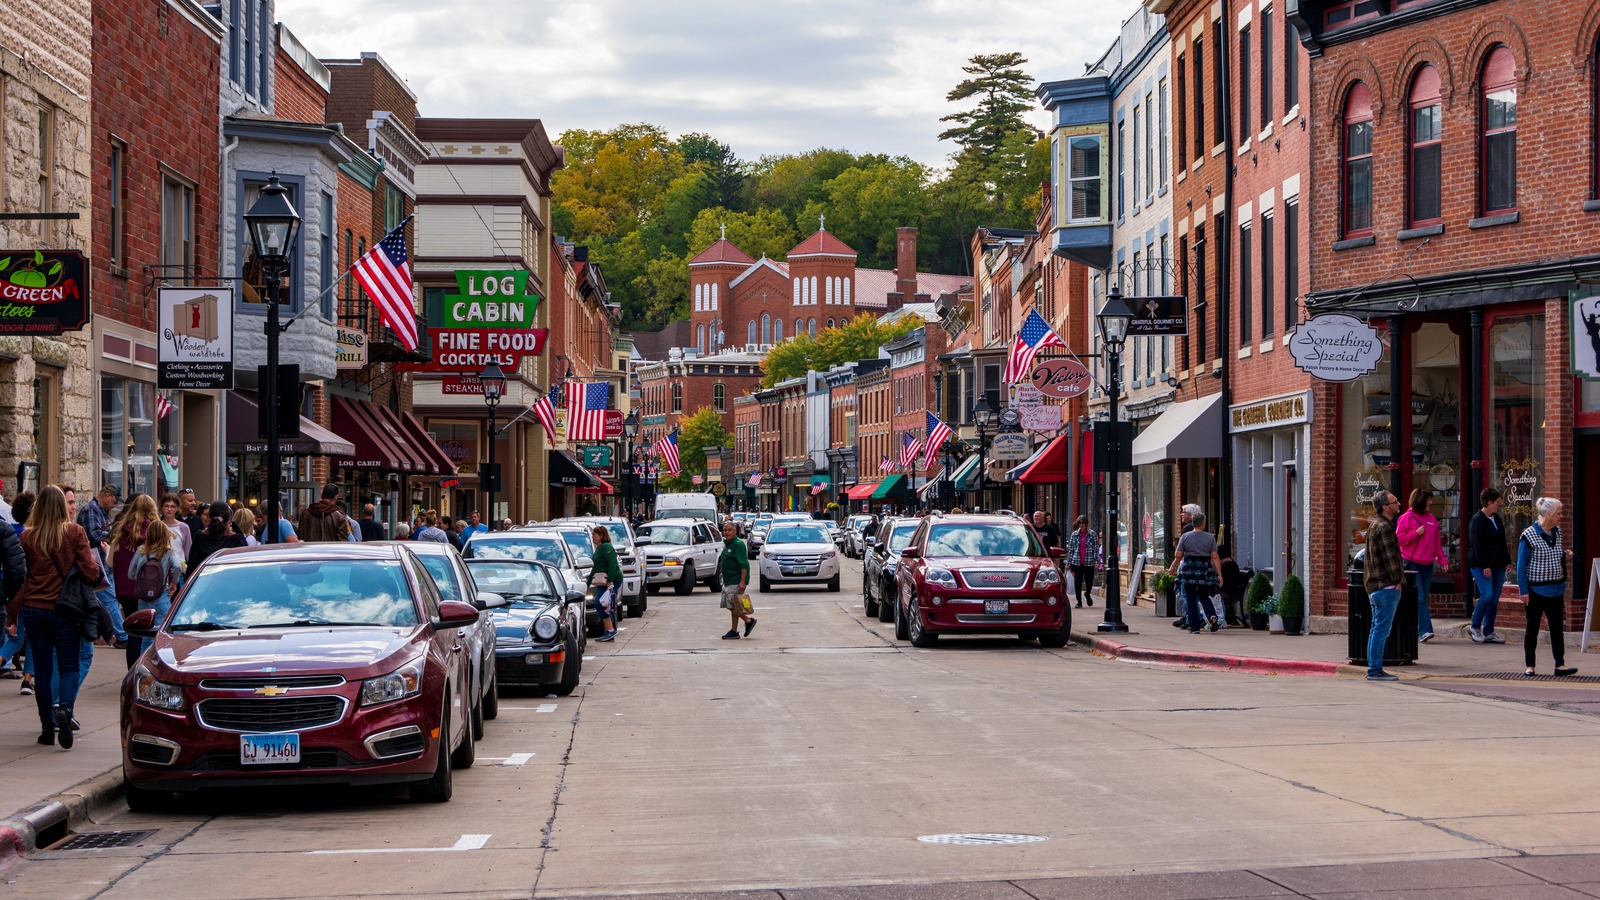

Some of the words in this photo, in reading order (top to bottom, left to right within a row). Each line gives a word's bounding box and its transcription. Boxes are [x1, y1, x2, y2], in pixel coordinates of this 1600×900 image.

[3, 285, 63, 301] GREEN
[468, 276, 515, 296] LOG
[452, 302, 524, 322] CABIN
[164, 328, 206, 357] Wooden
[439, 333, 480, 350] FINE
[487, 333, 536, 350] FOOD
[1298, 329, 1372, 354] Something
[1304, 345, 1362, 365] Special
[167, 363, 190, 372] Clothing
[187, 372, 224, 381] Woodworking
[1032, 366, 1090, 390] Victory
[1057, 384, 1080, 392] cafe
[440, 479, 460, 488] OPEN
[1353, 471, 1379, 489] Something
[1504, 469, 1537, 486] Something
[1507, 485, 1534, 505] Special
[243, 743, 257, 758] CJ
[263, 742, 297, 758] 91460
